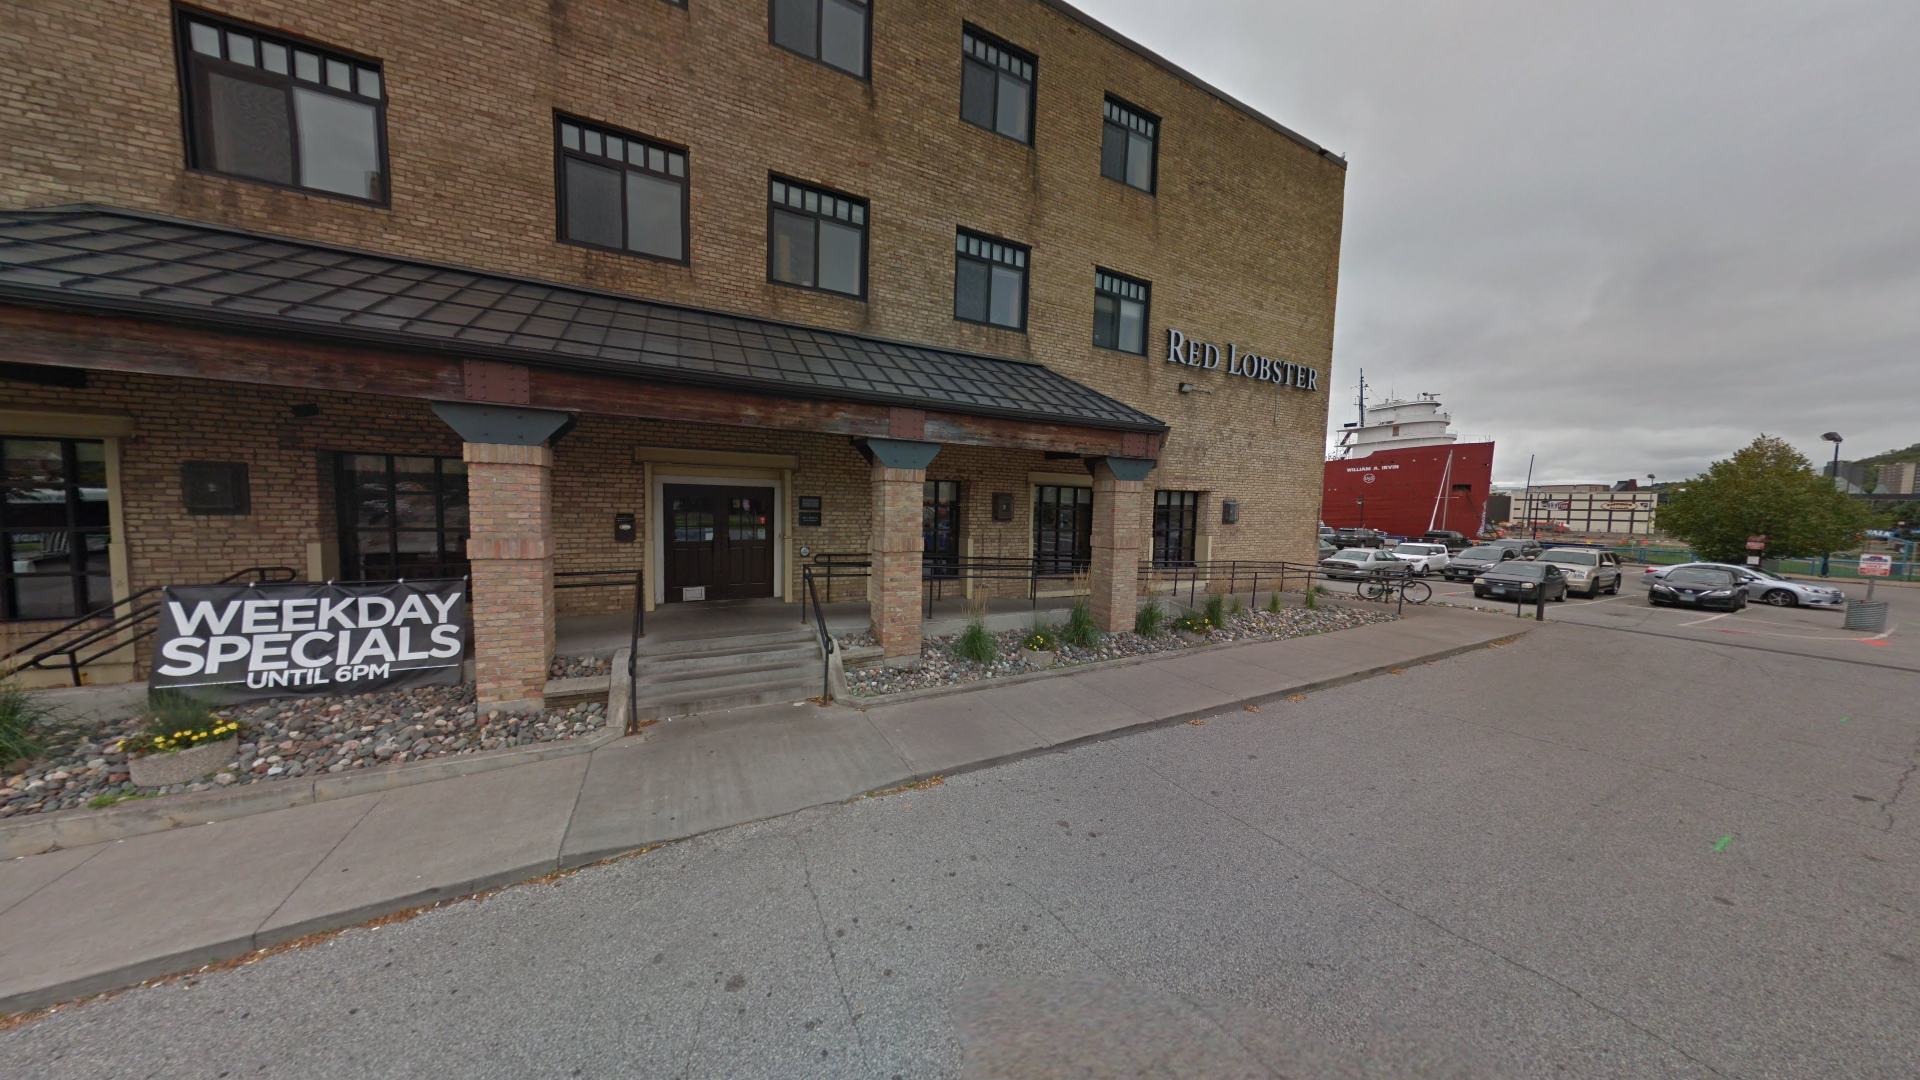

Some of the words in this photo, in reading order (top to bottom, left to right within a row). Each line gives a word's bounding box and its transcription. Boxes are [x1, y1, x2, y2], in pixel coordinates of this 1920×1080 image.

[1166, 328, 1220, 370] RED
[1227, 343, 1318, 391] LOBSTER
[168, 592, 462, 636] WEEKDAY
[157, 624, 461, 677] SPECIALS
[246, 668, 330, 690] UNTIL
[335, 663, 390, 684] 6PM
